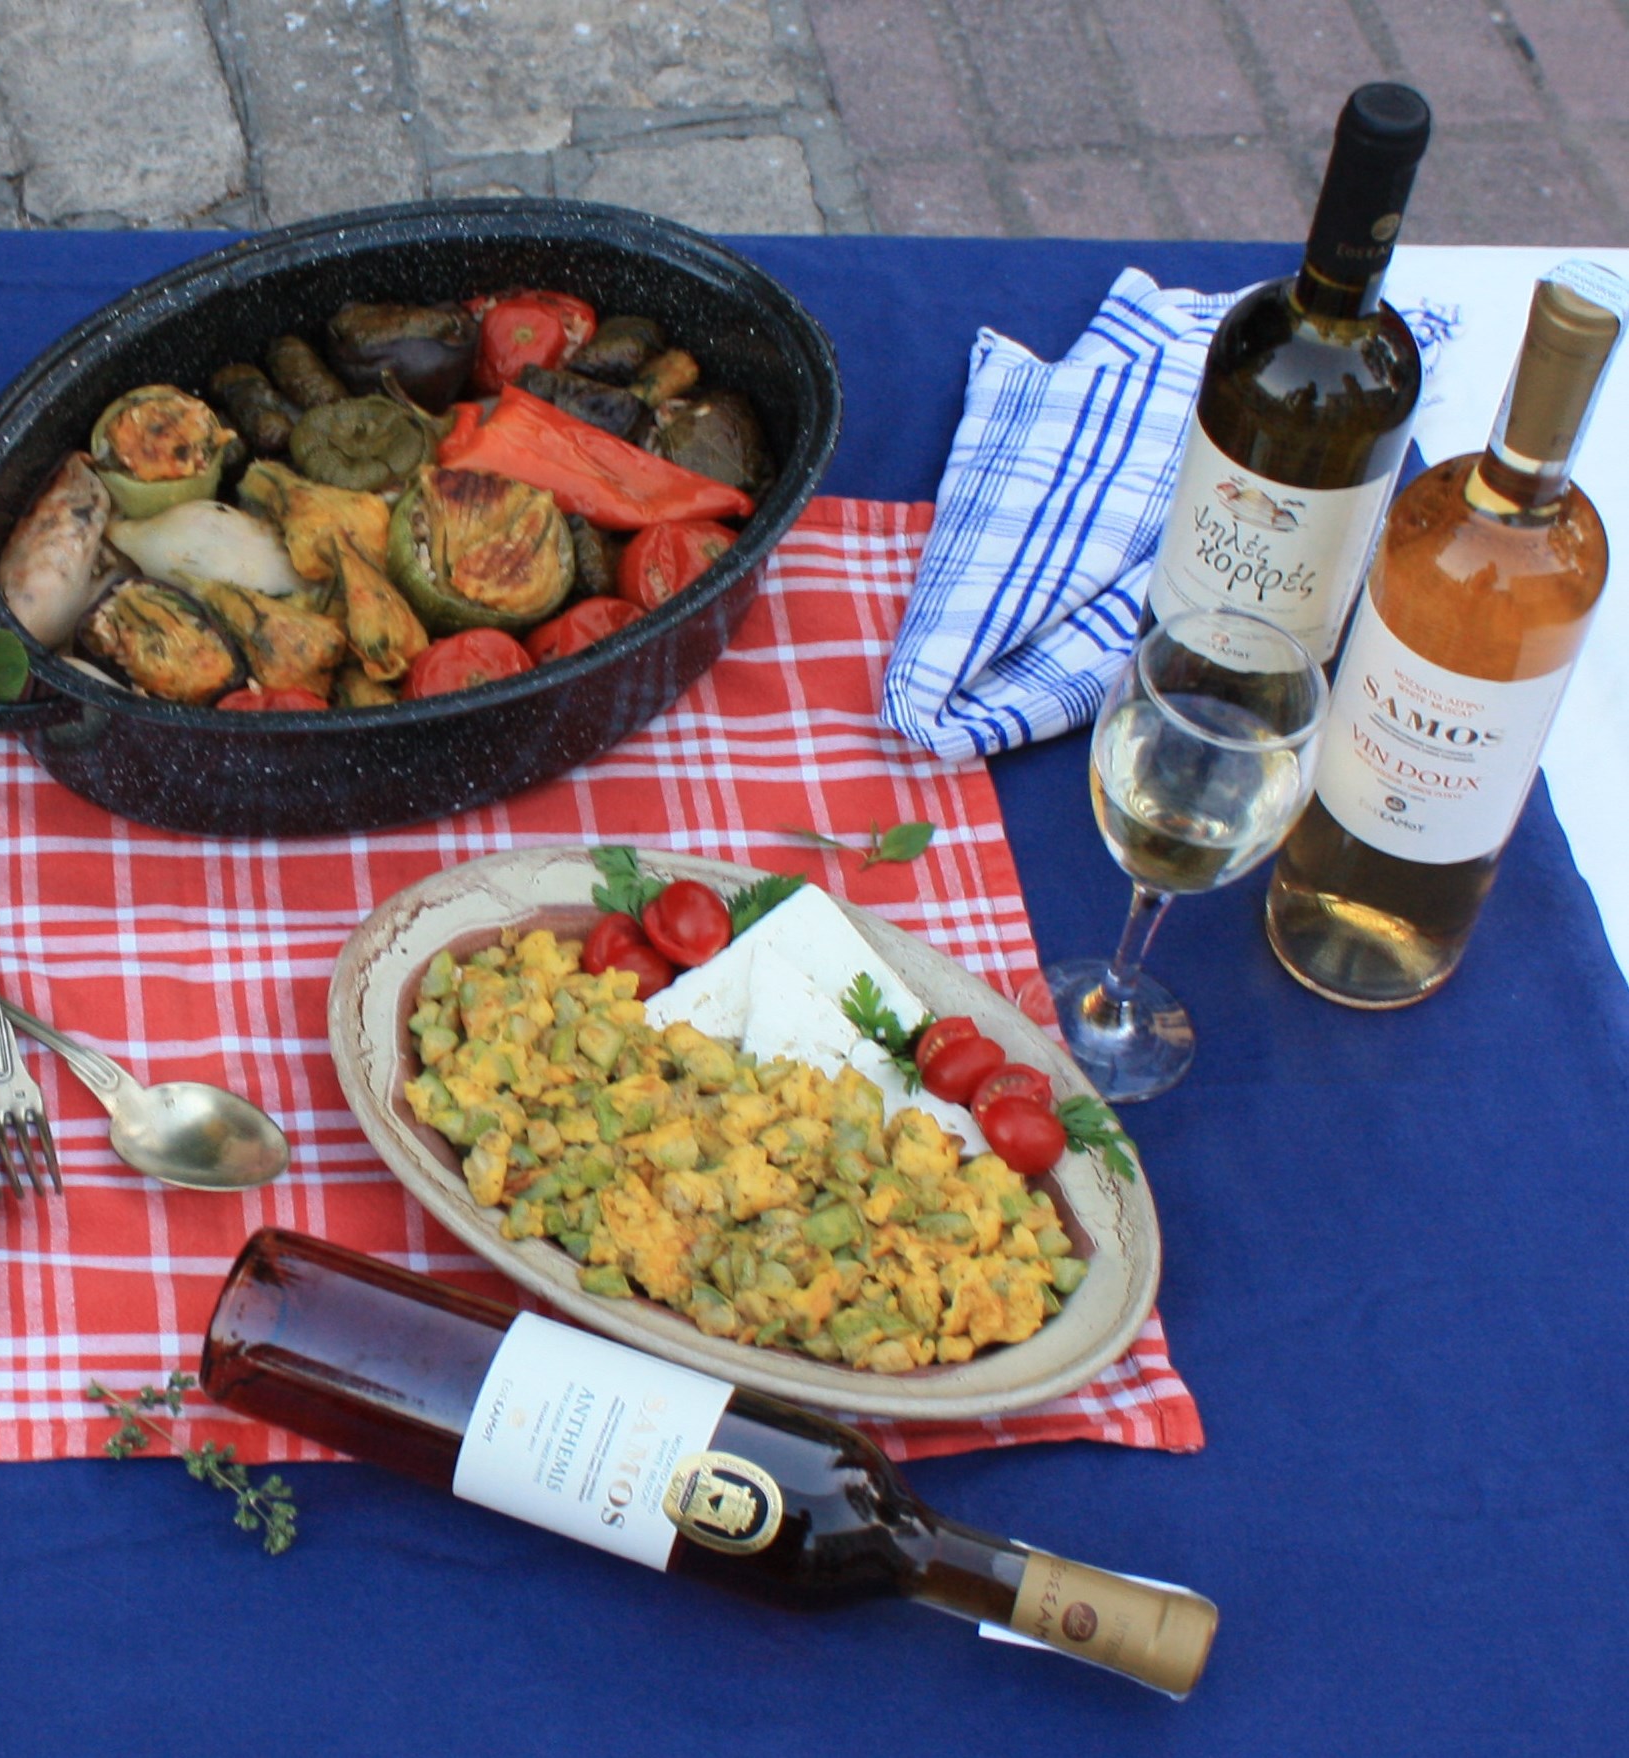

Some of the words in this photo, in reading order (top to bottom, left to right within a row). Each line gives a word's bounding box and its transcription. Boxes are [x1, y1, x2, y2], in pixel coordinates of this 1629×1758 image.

[1352, 722, 1390, 765] VIN
[1396, 758, 1482, 791] DOUX
[1363, 675, 1504, 748] SAMOS
[545, 1386, 595, 1493] ANTHEMIS
[601, 1393, 667, 1529] SAMOS
